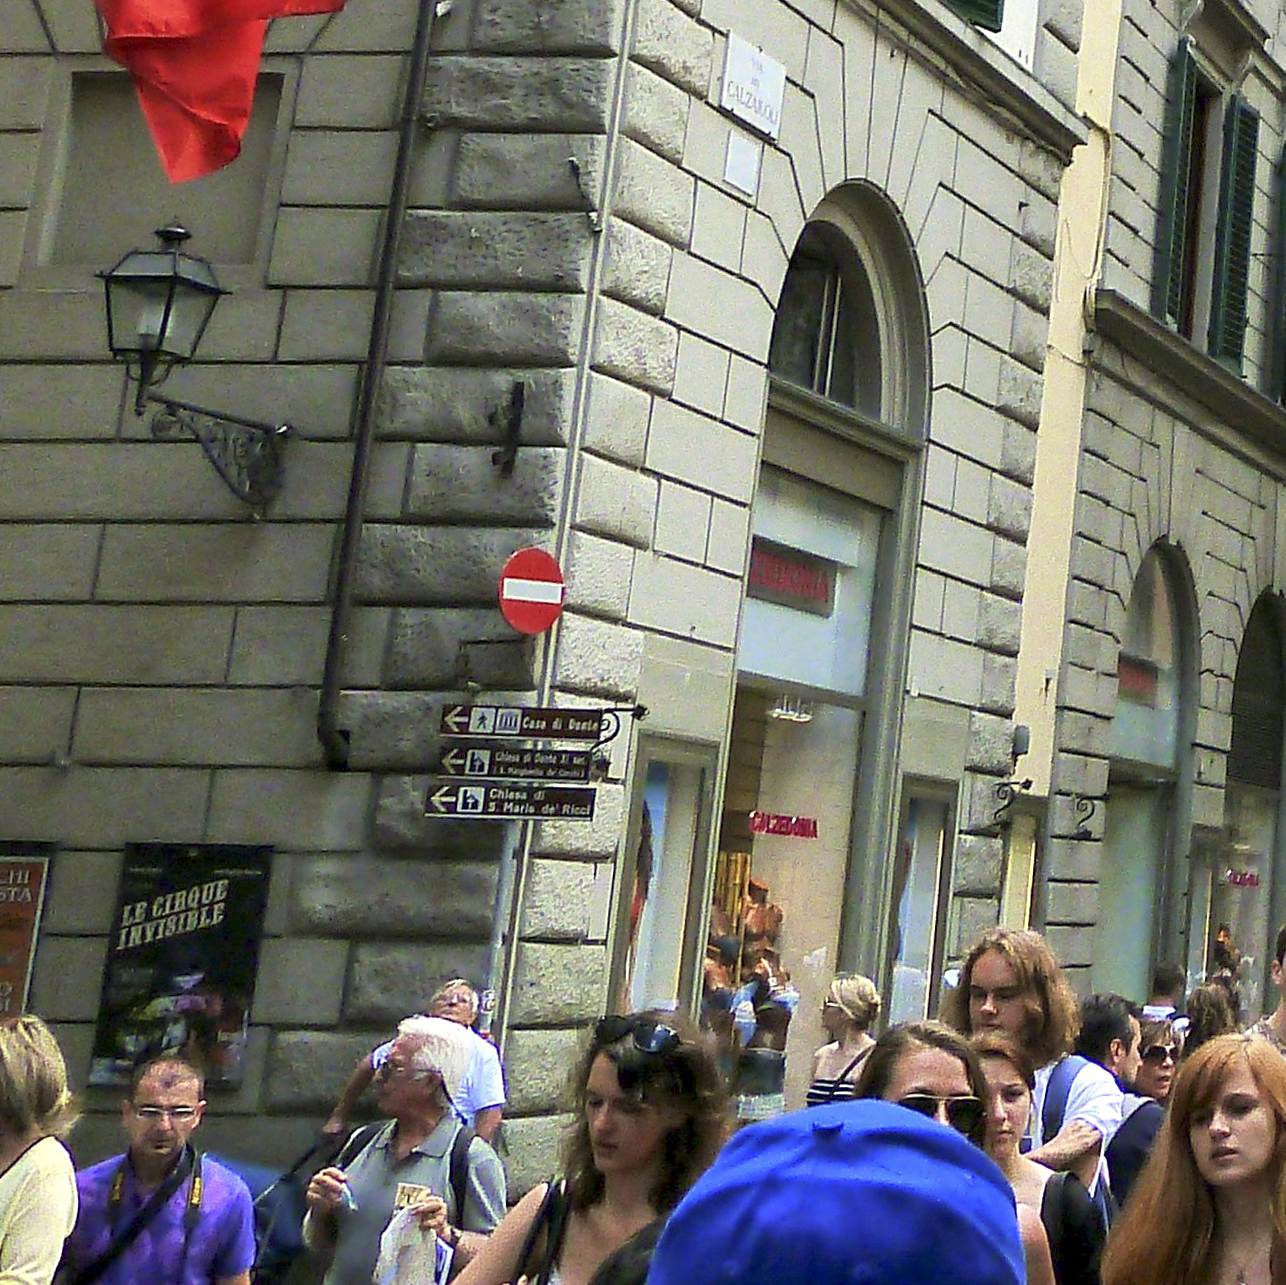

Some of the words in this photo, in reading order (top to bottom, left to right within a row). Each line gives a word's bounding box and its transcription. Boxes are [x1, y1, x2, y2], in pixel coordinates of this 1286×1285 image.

[522, 716, 547, 730] Casa
[552, 717, 563, 730] di
[568, 718, 599, 732] Dante
[489, 788, 527, 801] Chiesa
[534, 790, 545, 801] di
[487, 801, 499, 813] S.
[503, 801, 535, 814] Maria
[562, 803, 591, 816] Ricci
[121, 901, 148, 928] LE
[152, 878, 229, 917] CIRQUE
[116, 902, 226, 950] INVISIBLE
